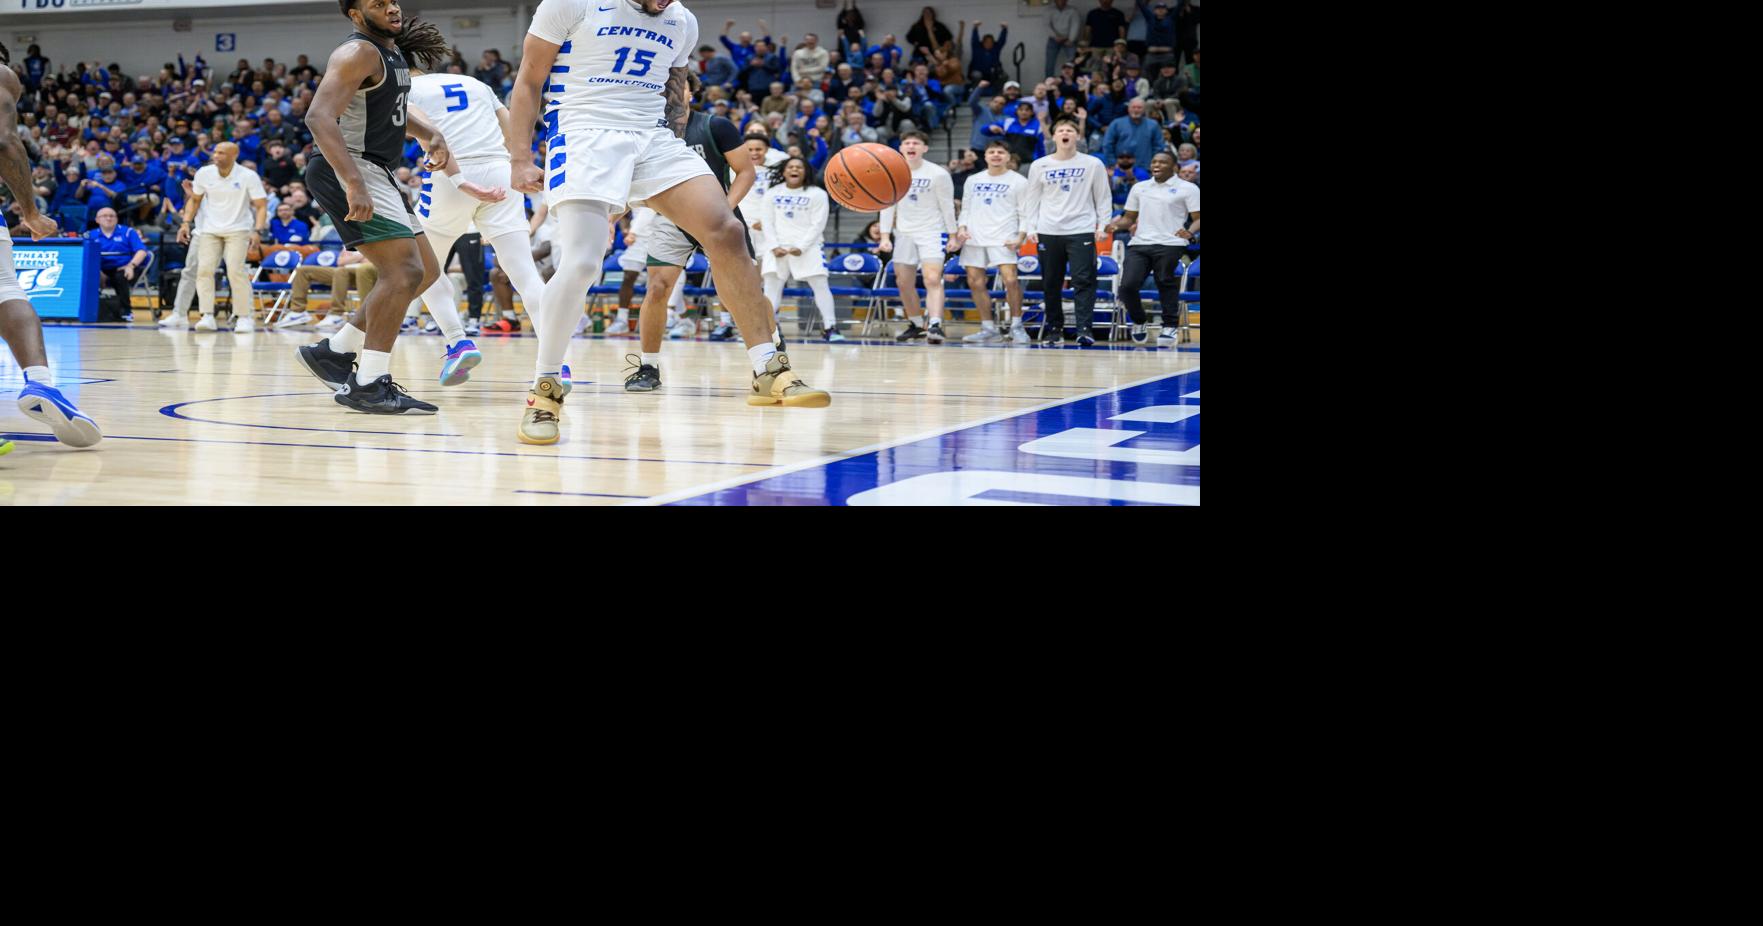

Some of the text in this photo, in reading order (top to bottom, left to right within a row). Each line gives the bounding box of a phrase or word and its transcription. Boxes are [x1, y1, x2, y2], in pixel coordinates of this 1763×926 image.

[218, 34, 233, 51] 3
[597, 26, 674, 50] CENTRAL
[611, 46, 657, 77] 15
[588, 77, 663, 91] CONNECTICUT
[440, 83, 469, 113] 5
[1045, 167, 1086, 181] CCSU
[974, 183, 1010, 194] CCSU
[774, 195, 810, 206] CCSU
[15, 264, 64, 290] EC
